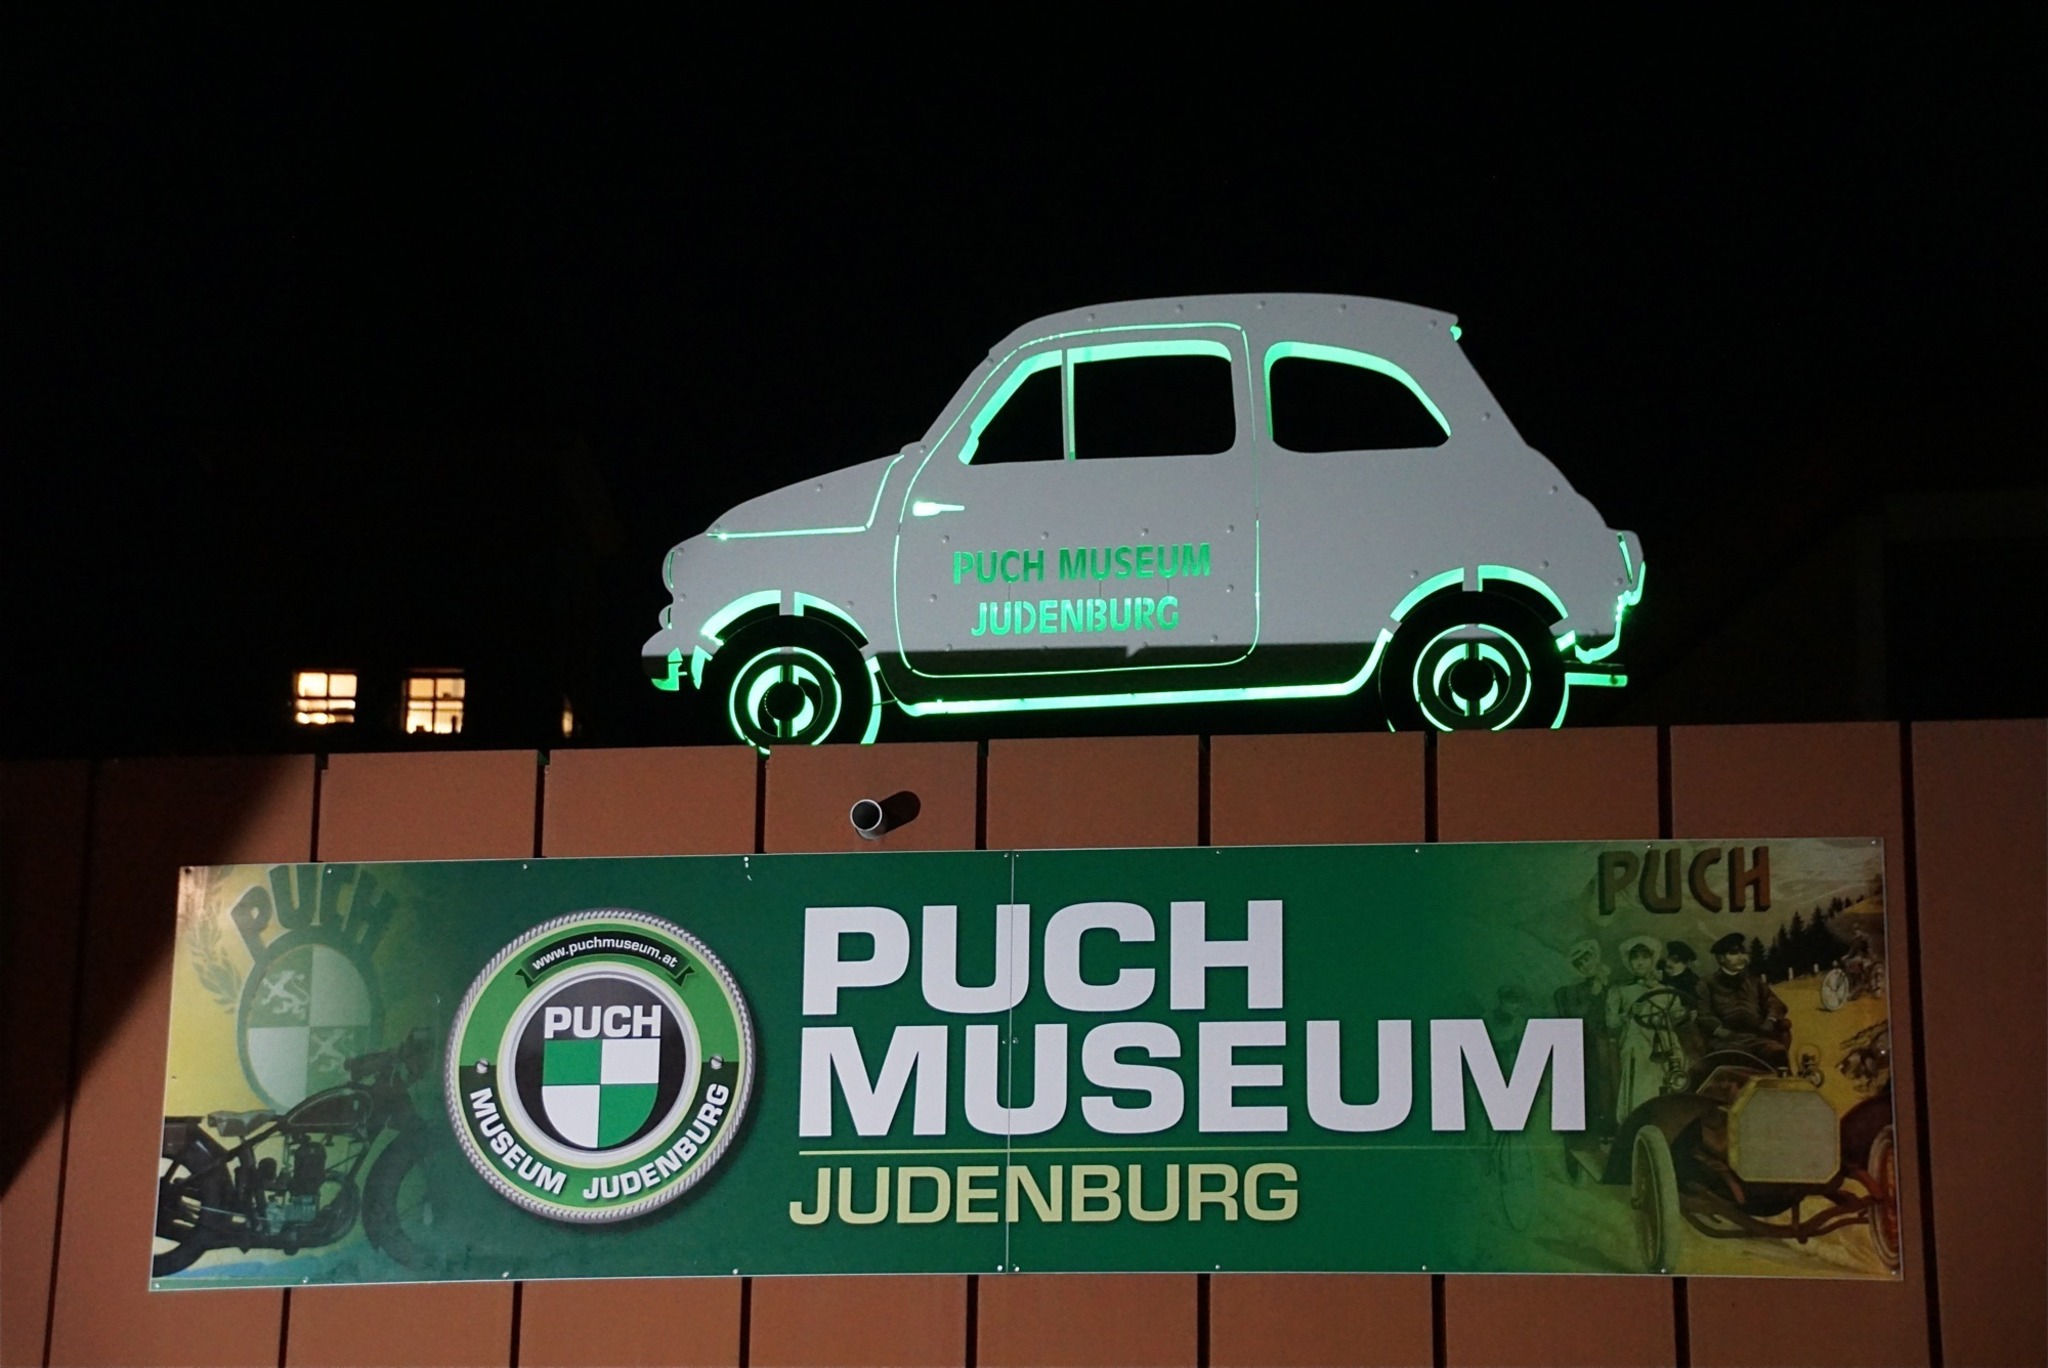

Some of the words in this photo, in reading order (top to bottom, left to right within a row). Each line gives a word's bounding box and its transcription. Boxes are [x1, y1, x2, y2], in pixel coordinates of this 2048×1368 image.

[953, 549, 1045, 585] PUCH
[1059, 542, 1211, 581] MUSEUM
[970, 595, 1179, 637] JUDENBURG
[1598, 846, 1771, 916] PUCH
[531, 936, 679, 972] www.puchmuseum.at
[801, 899, 1284, 1016] PUCH
[543, 1004, 663, 1040] PUCH
[799, 1018, 1587, 1138] MUSEUM
[469, 1086, 568, 1196] MUSEUM
[582, 1081, 731, 1200] JUDENBURG
[789, 1162, 1300, 1226] JUDENBURG
